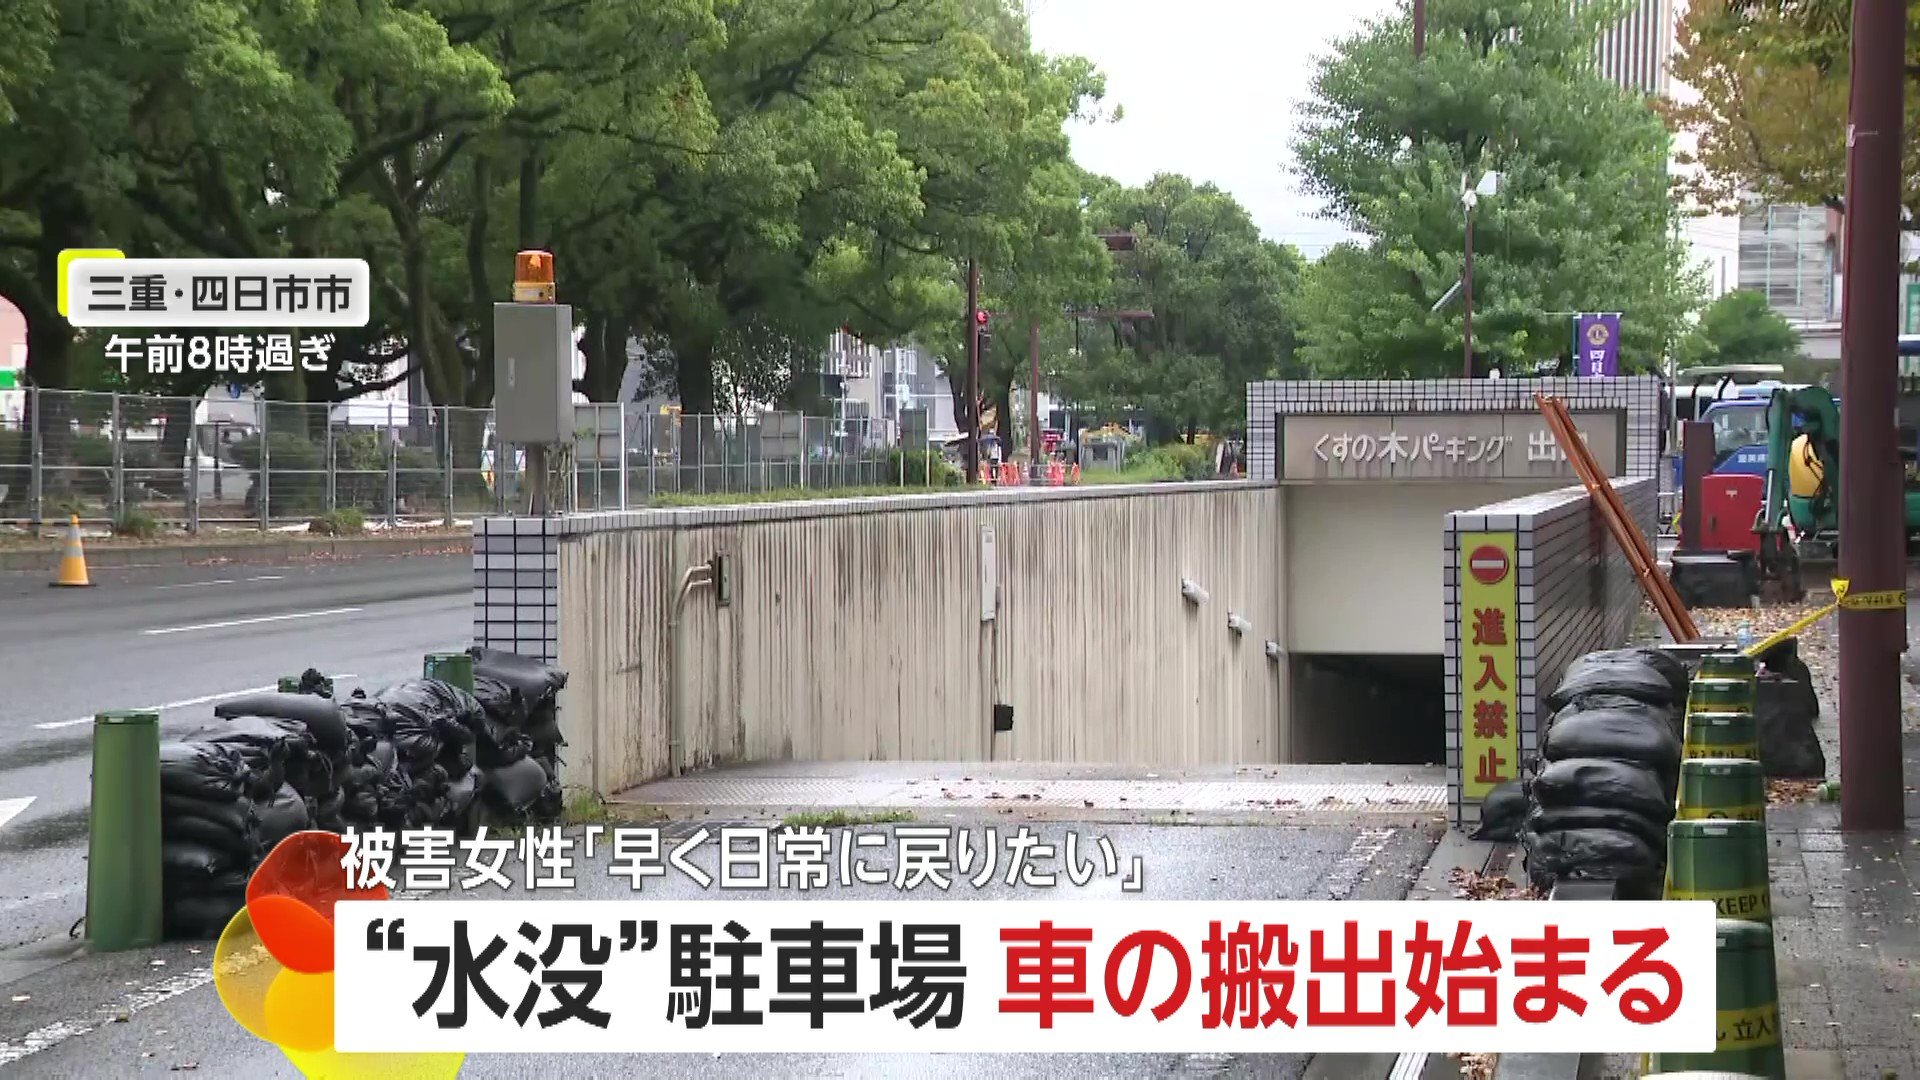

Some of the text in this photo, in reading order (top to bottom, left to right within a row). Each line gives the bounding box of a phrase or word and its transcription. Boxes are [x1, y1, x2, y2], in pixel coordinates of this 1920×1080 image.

[1313, 429, 1589, 463] くすの木パーキング 出
[1472, 606, 1508, 784] 進入禁止
